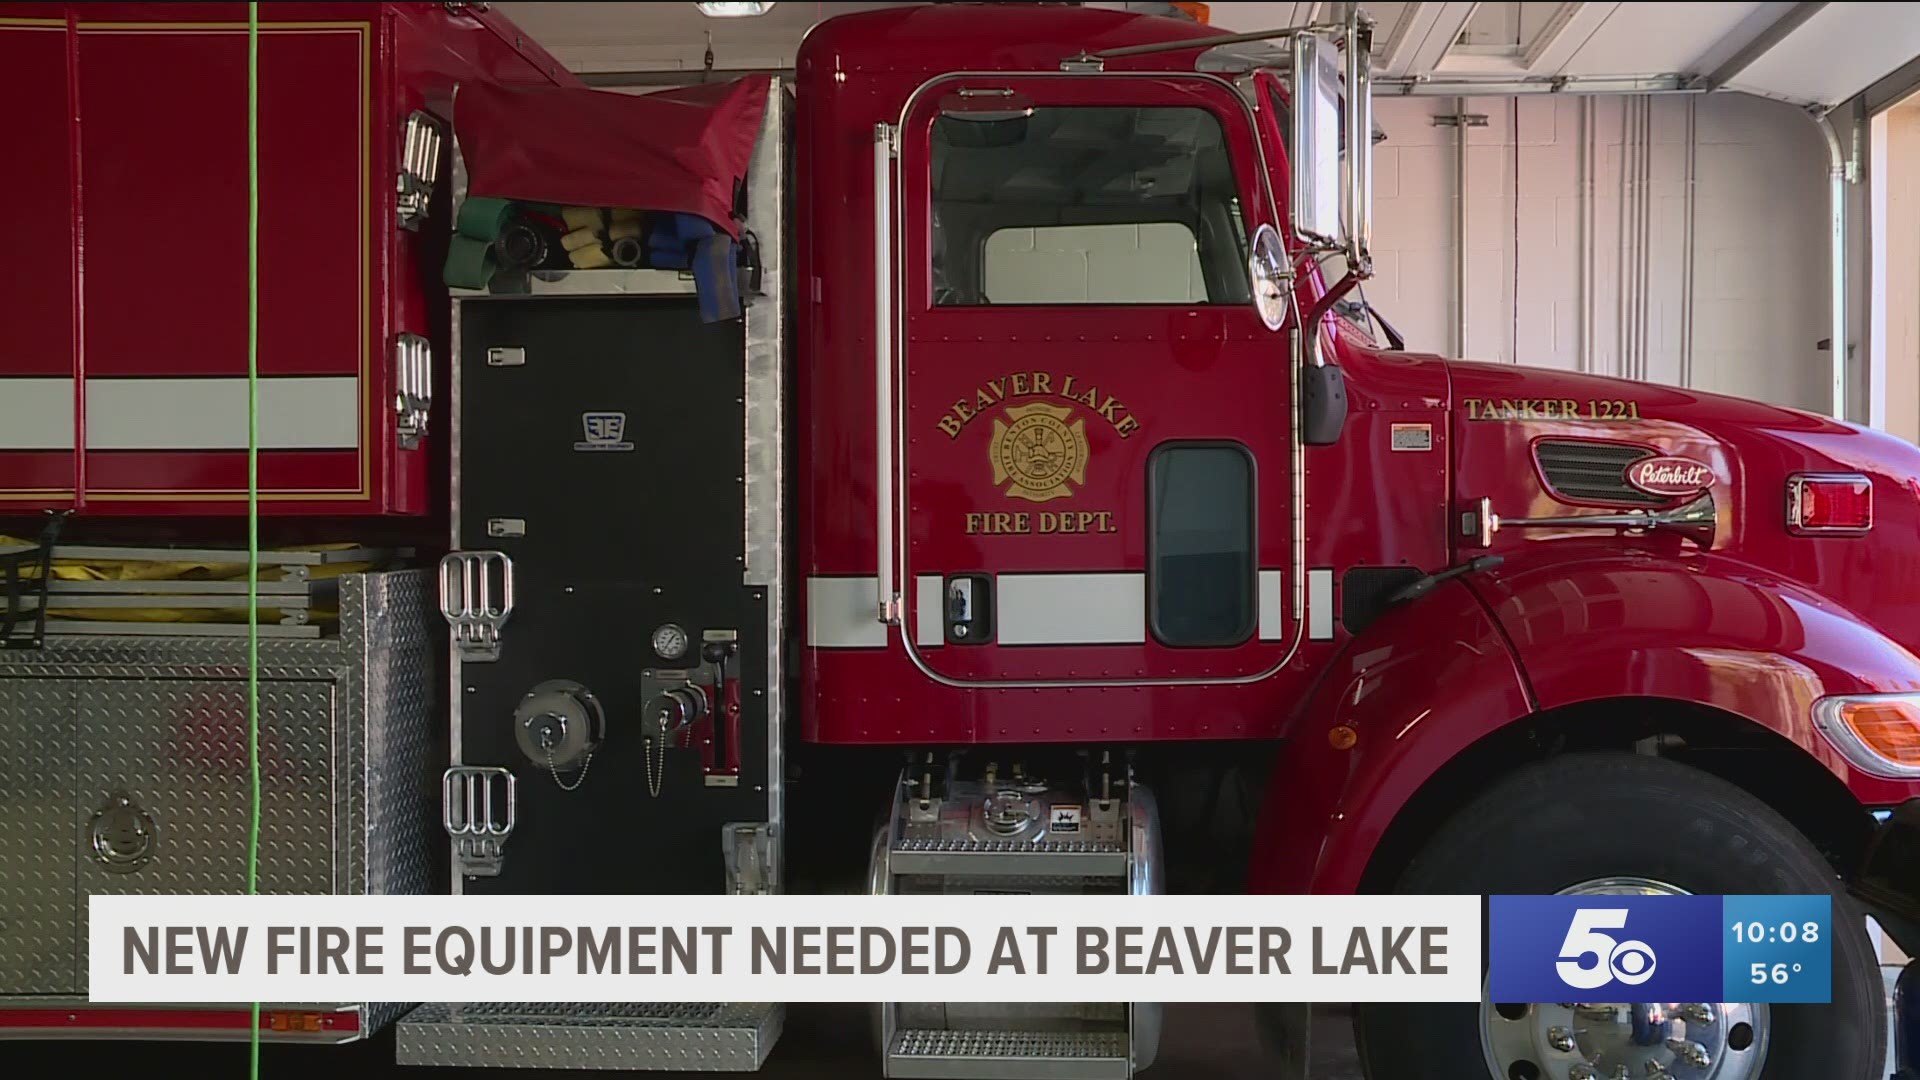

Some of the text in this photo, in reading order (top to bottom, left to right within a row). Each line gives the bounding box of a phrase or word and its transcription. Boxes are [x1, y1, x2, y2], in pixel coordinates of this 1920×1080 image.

[936, 371, 1141, 440] BEAVER LAKE
[1464, 398, 1641, 421] TANKER 1221
[1639, 463, 1709, 485] Peterbilt
[965, 510, 1118, 535] FIRE DEPT.
